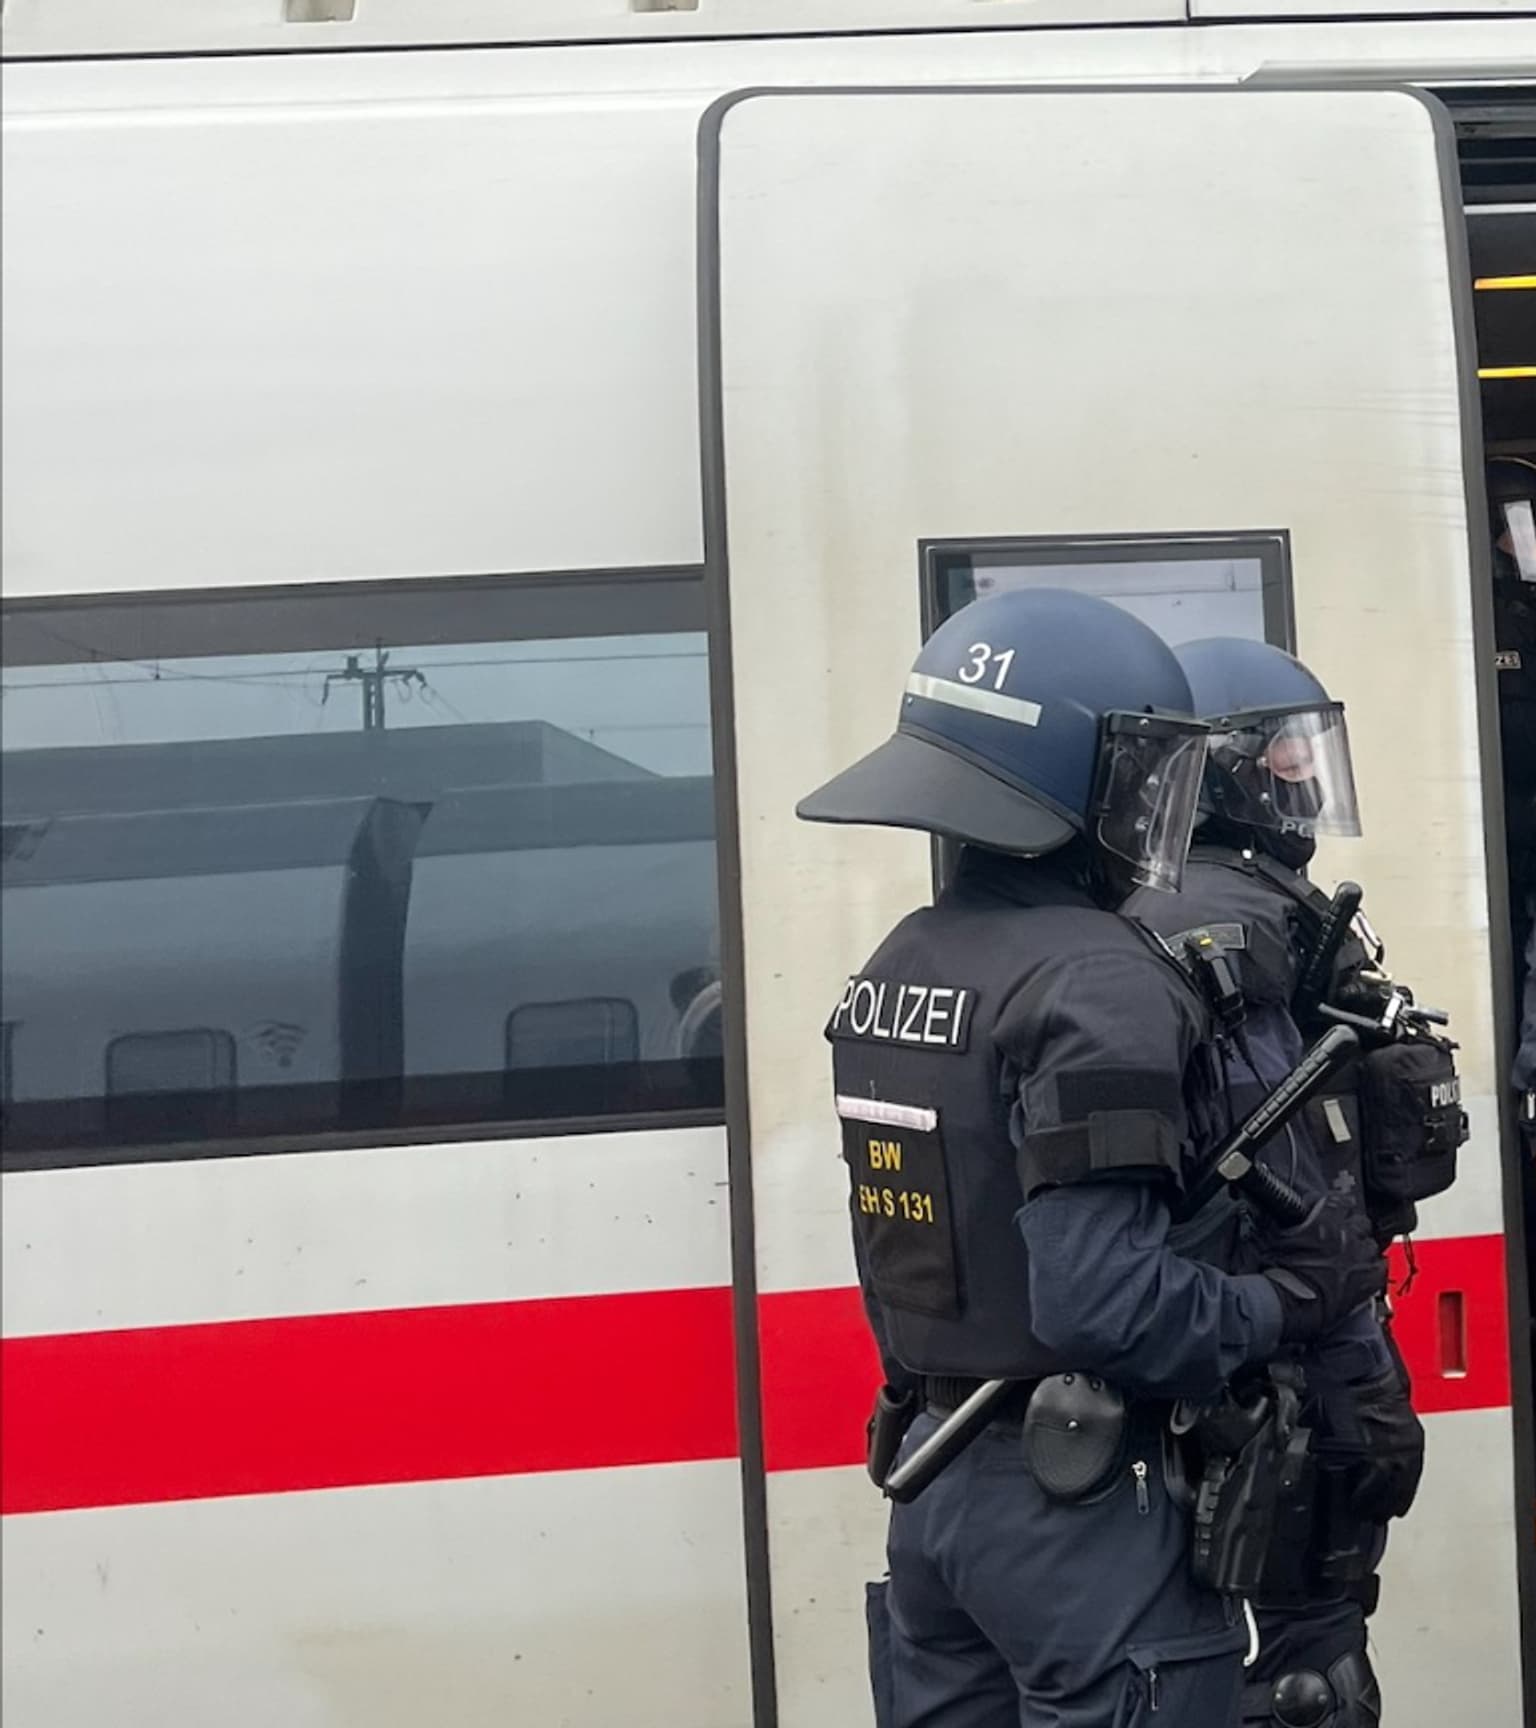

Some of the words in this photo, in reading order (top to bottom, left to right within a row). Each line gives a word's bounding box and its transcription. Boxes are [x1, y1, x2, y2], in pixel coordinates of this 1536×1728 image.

[958, 642, 1016, 690] 31
[833, 979, 967, 1046] POLIZEI
[868, 1140, 901, 1171] BW
[859, 1184, 881, 1216] EH
[882, 1187, 896, 1219] S
[900, 1190, 934, 1223] 131
